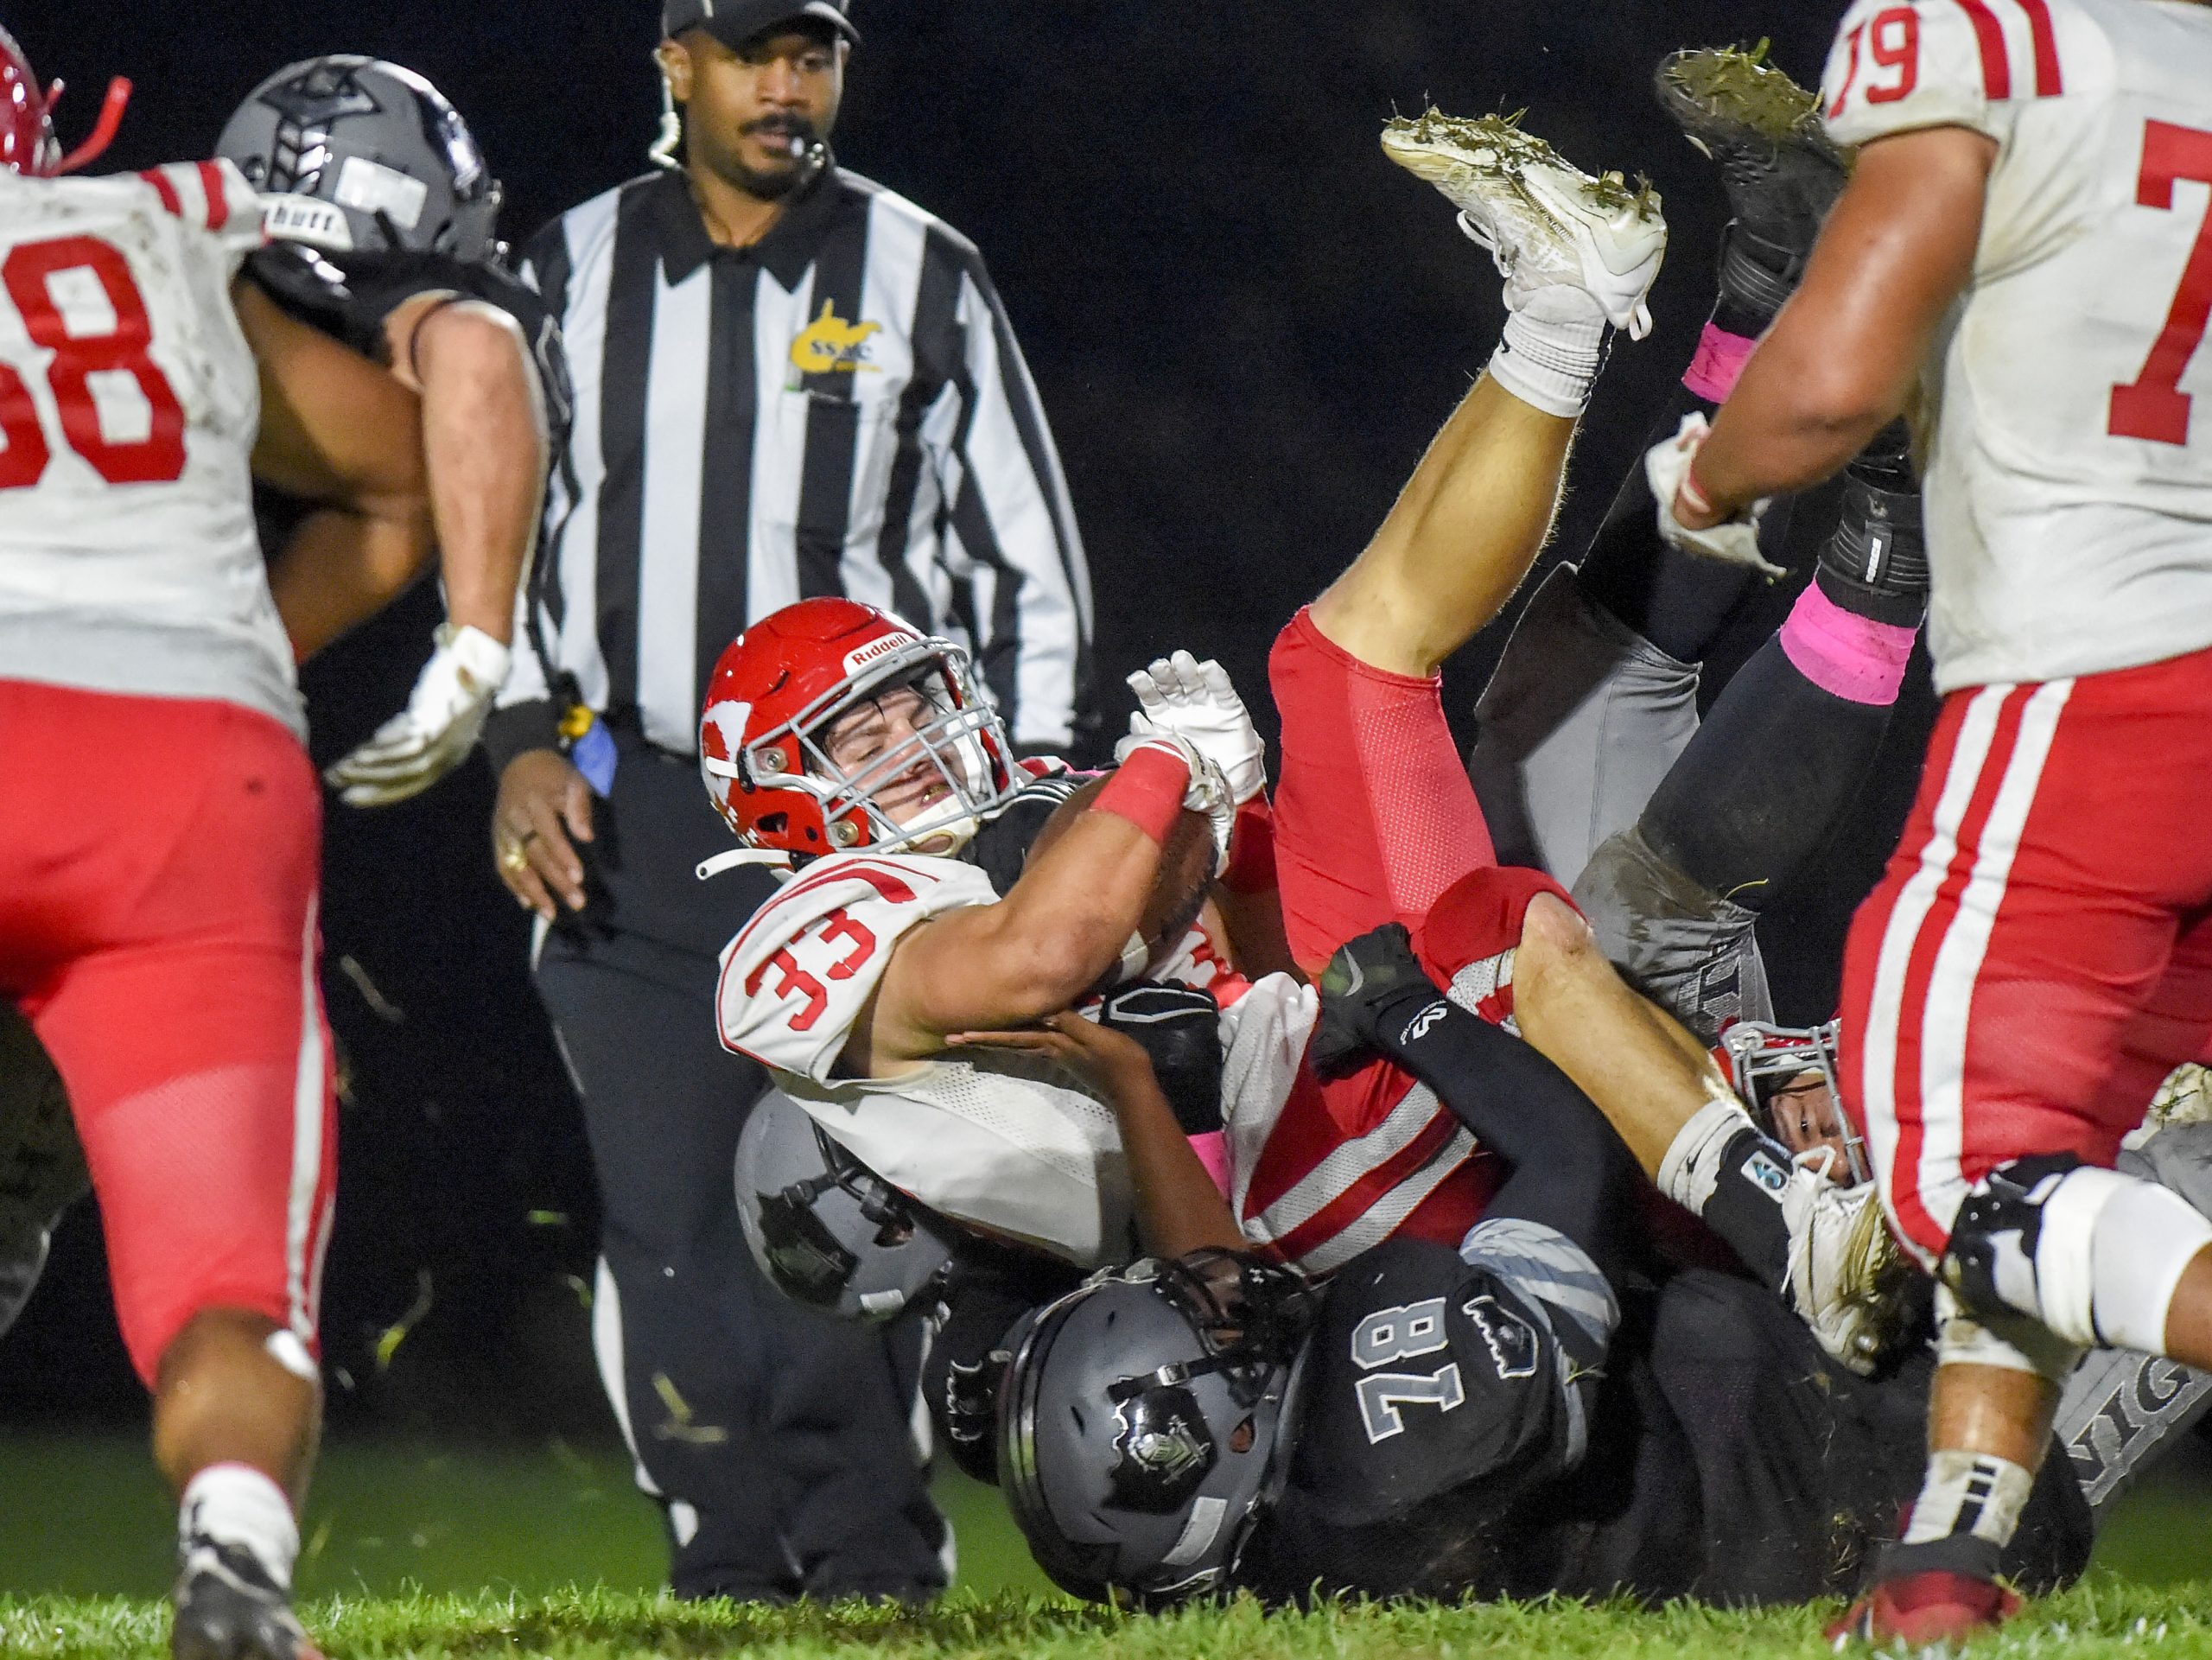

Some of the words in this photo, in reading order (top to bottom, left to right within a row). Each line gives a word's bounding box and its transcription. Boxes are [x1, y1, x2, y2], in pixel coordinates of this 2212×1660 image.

[851, 633, 907, 665] Riddell
[745, 907, 876, 1032] 33
[1351, 1297, 1465, 1445] 78
